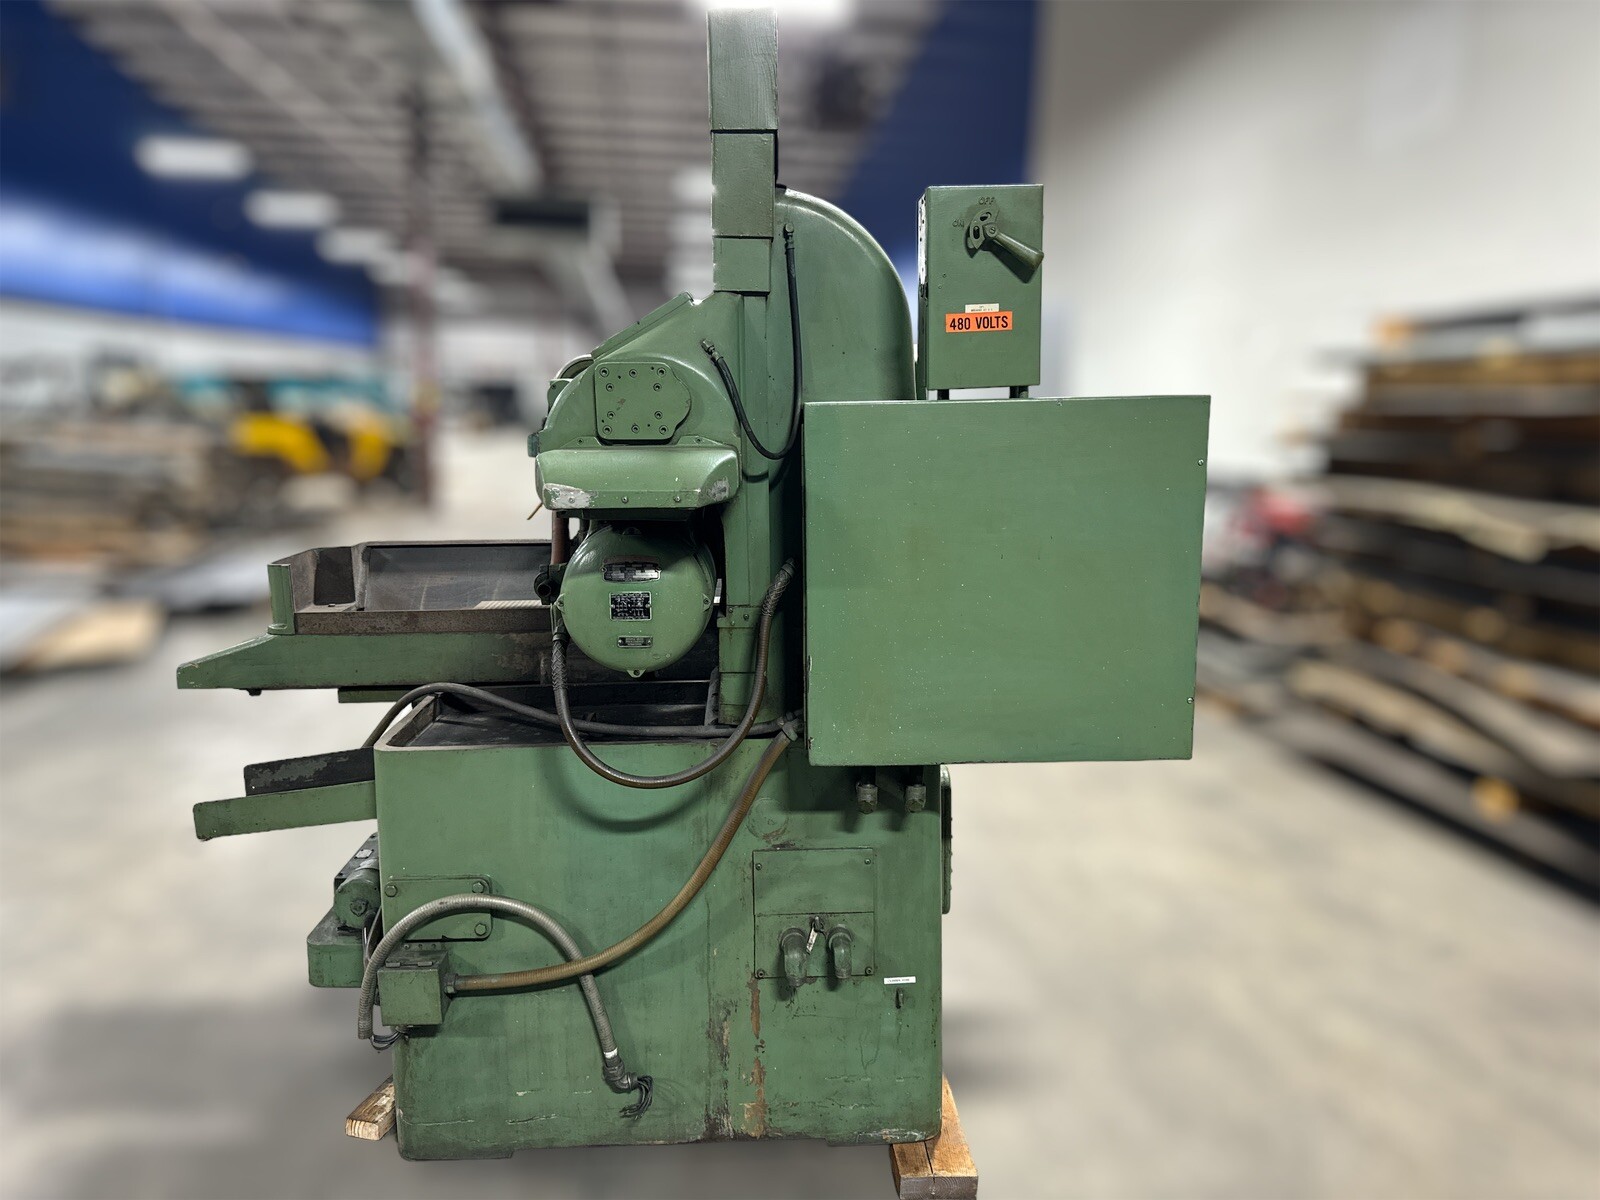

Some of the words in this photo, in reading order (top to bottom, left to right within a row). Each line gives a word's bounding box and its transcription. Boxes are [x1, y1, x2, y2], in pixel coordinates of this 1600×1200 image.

[979, 196, 996, 205] OFF
[952, 219, 965, 228] ON
[949, 317, 971, 331] 480
[975, 315, 1008, 329] VOLTS
